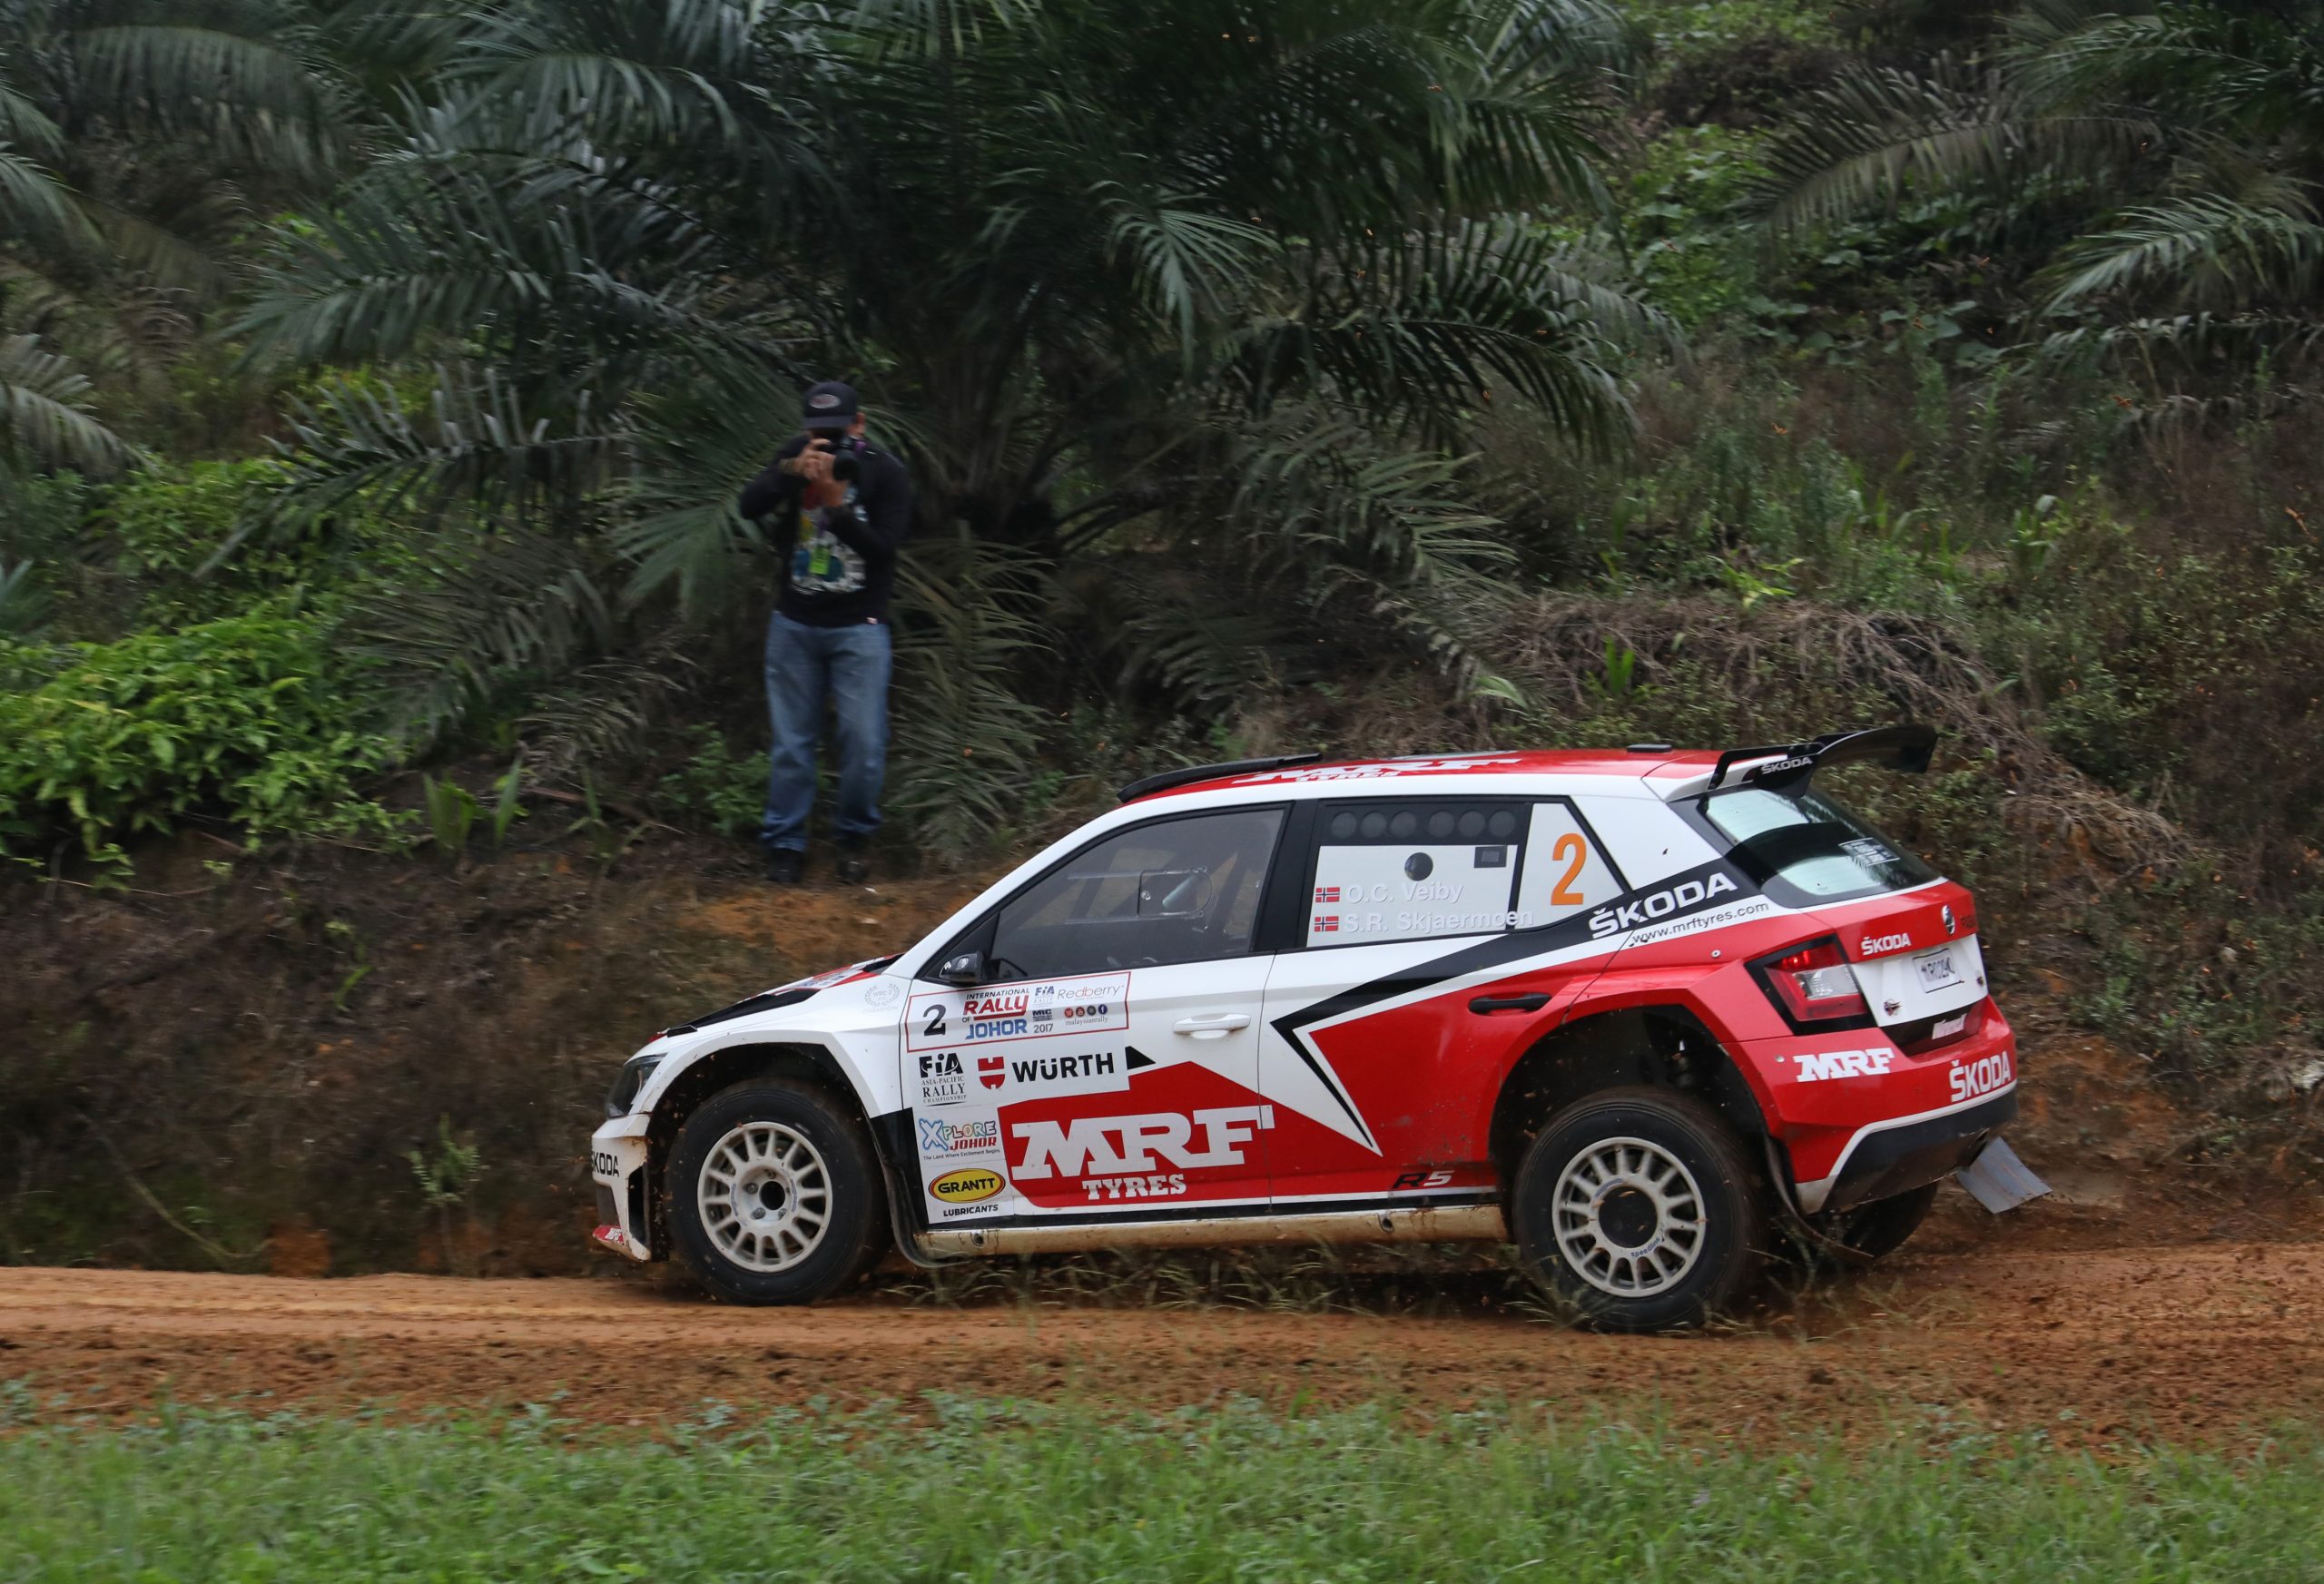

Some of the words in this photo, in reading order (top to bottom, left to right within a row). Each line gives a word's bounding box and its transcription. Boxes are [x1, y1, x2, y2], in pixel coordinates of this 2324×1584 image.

[1551, 832, 1587, 906] 2
[1346, 884, 1394, 904] O.C.
[1403, 881, 1466, 904] Veiby
[1589, 871, 1738, 940] ŠKODA
[1344, 913, 1390, 933] S.R.
[1397, 910, 1535, 935] Skjaermoen
[1632, 902, 1770, 943] www.mrftyres.com
[1861, 932, 1912, 956] ŠKODA
[966, 988, 1030, 1000] INTERNATIONAL
[1058, 985, 1121, 999] Redberry
[962, 995, 1029, 1016] RALLY
[923, 1004, 947, 1037] 2
[965, 1018, 1028, 1039] JOHOR
[1033, 1023, 1053, 1033] 2017
[1066, 1016, 1108, 1026] malaysianrally
[1011, 1052, 1114, 1083] WÜRTH
[1792, 1048, 1895, 1083] MRF
[921, 1076, 964, 1086] ASIA-PACIFIC
[1949, 1050, 2011, 1103] ŠKODA
[922, 1083, 965, 1097] RALLY
[923, 1095, 967, 1104] CHAMPIONSHIP
[950, 1136, 997, 1151] JOHOR
[1011, 1105, 1275, 1180] MRF
[938, 1177, 995, 1194] GRANTT
[1082, 1174, 1187, 1201] TYRES
[1391, 1170, 1455, 1190] R5
[943, 1205, 999, 1217] LUBRICANTS
